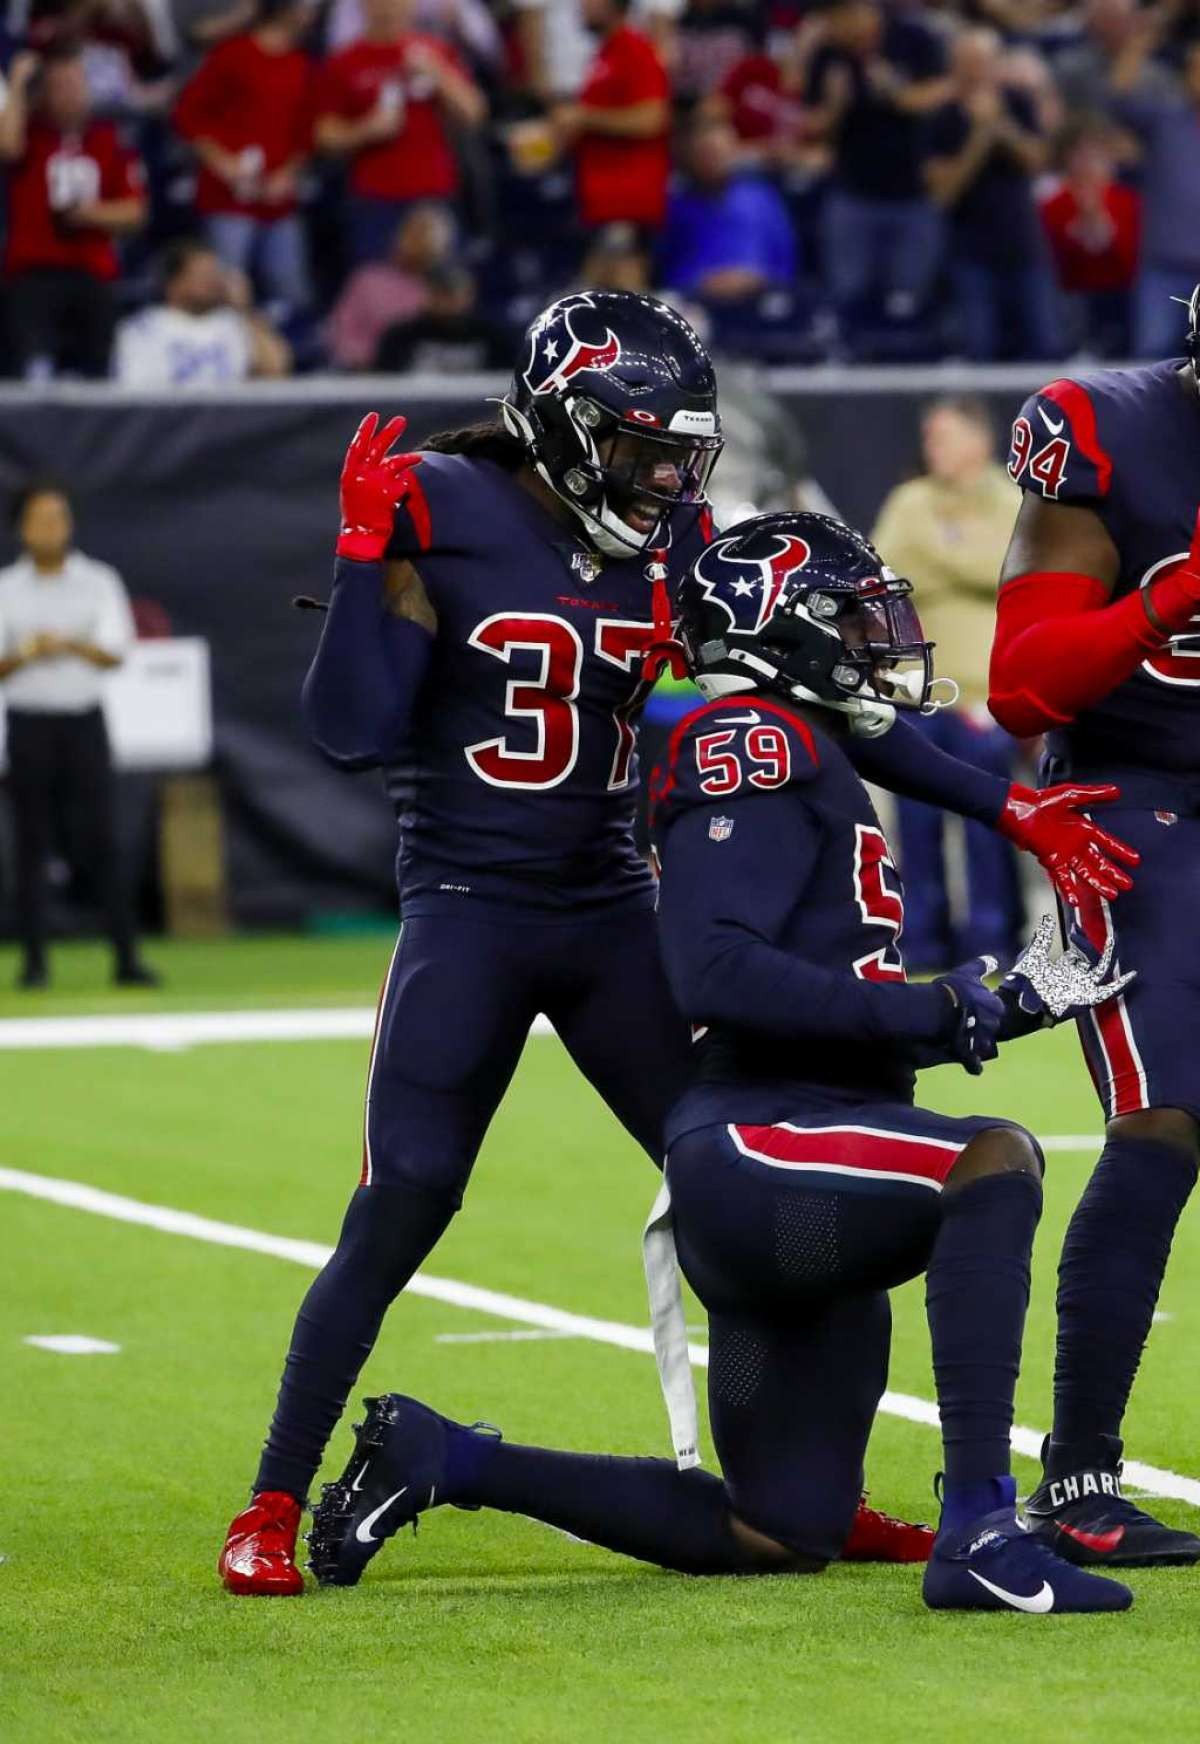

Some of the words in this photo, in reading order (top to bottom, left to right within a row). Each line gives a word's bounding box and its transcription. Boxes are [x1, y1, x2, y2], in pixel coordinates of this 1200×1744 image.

[1007, 416, 1070, 500] 94
[464, 611, 682, 791] 37
[696, 725, 791, 795] 59
